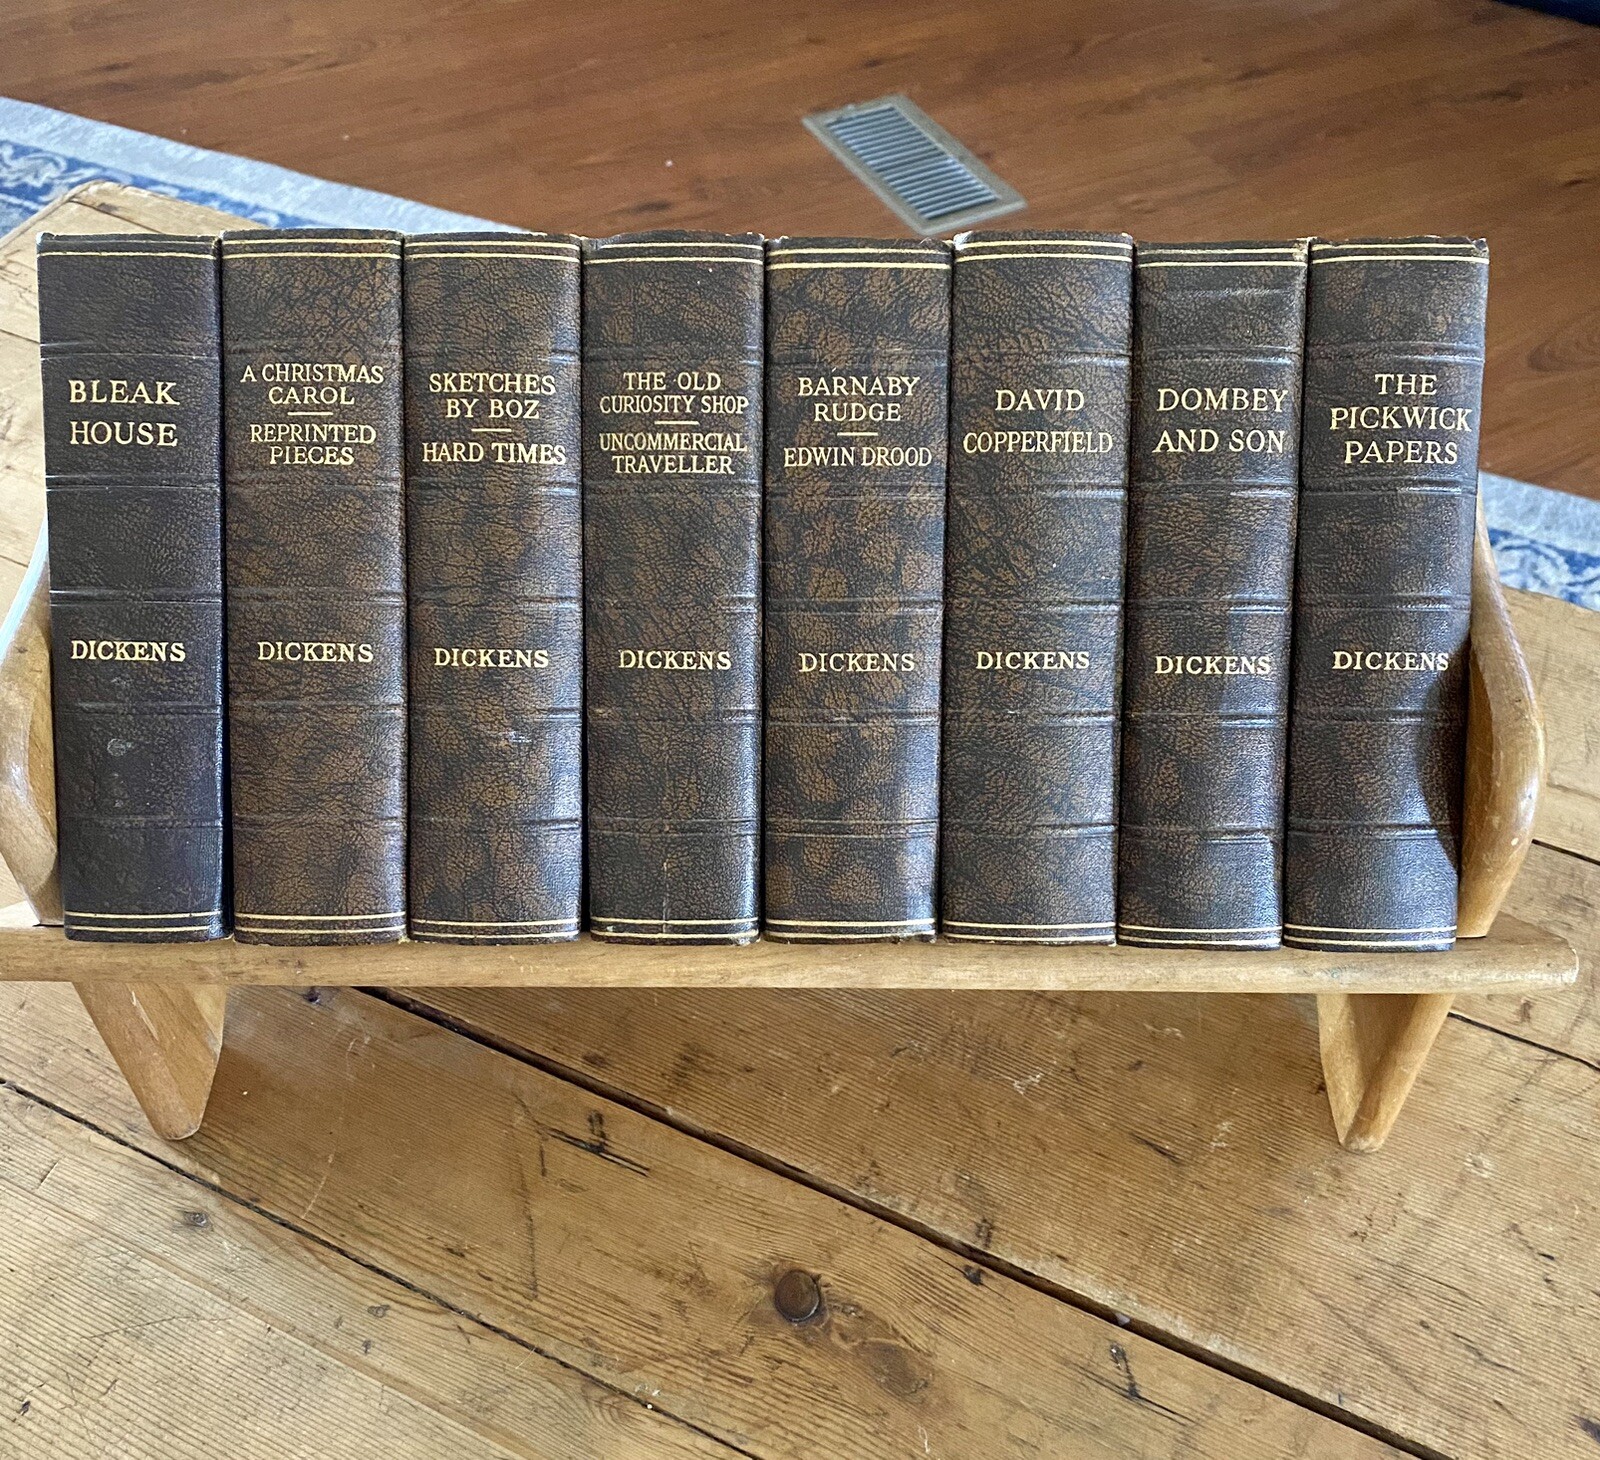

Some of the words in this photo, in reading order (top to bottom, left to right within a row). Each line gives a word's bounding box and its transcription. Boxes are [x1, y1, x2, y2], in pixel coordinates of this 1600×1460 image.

[241, 364, 257, 384] A
[260, 364, 384, 384] CHRISTMAS
[429, 373, 555, 395] SKETCHES
[624, 372, 668, 392] THE
[678, 372, 721, 392] OLD
[1376, 373, 1437, 396] THE
[69, 380, 180, 406] BLEAK
[268, 384, 354, 405] CAROL
[798, 376, 919, 397] BARNABY
[446, 398, 478, 419] BY
[489, 398, 539, 419] BOZ
[600, 394, 695, 415] CURIOSITY
[702, 394, 749, 416] SHOP
[996, 389, 1084, 412] DAVID
[1158, 388, 1288, 412] DOMBEY
[814, 402, 901, 422] RUDGE
[1331, 407, 1472, 432] PICKWICK
[70, 421, 178, 447] HOUSE
[250, 424, 376, 445] REPRINTED
[600, 432, 747, 454] UNCOMMERCIAL
[963, 431, 1112, 455] COPPERFIELD
[1154, 429, 1219, 454] AND
[1229, 429, 1285, 454] SON
[269, 444, 354, 466] PIECES
[422, 442, 484, 464] HARD
[492, 442, 566, 465] TIMES
[783, 446, 858, 468] EDWIN
[861, 446, 932, 468] DROOD
[1344, 441, 1459, 464] PAPERS
[612, 453, 734, 475] TRAVELLER
[71, 640, 186, 662] DICKENS
[258, 641, 374, 664] DICKENS
[434, 648, 549, 669] DICKENS
[619, 649, 731, 671] DICKENS
[799, 652, 915, 672] DICKENS
[977, 650, 1089, 671] DICKENS
[1333, 651, 1449, 672] DICKENS
[1155, 654, 1271, 676] DICKENS
